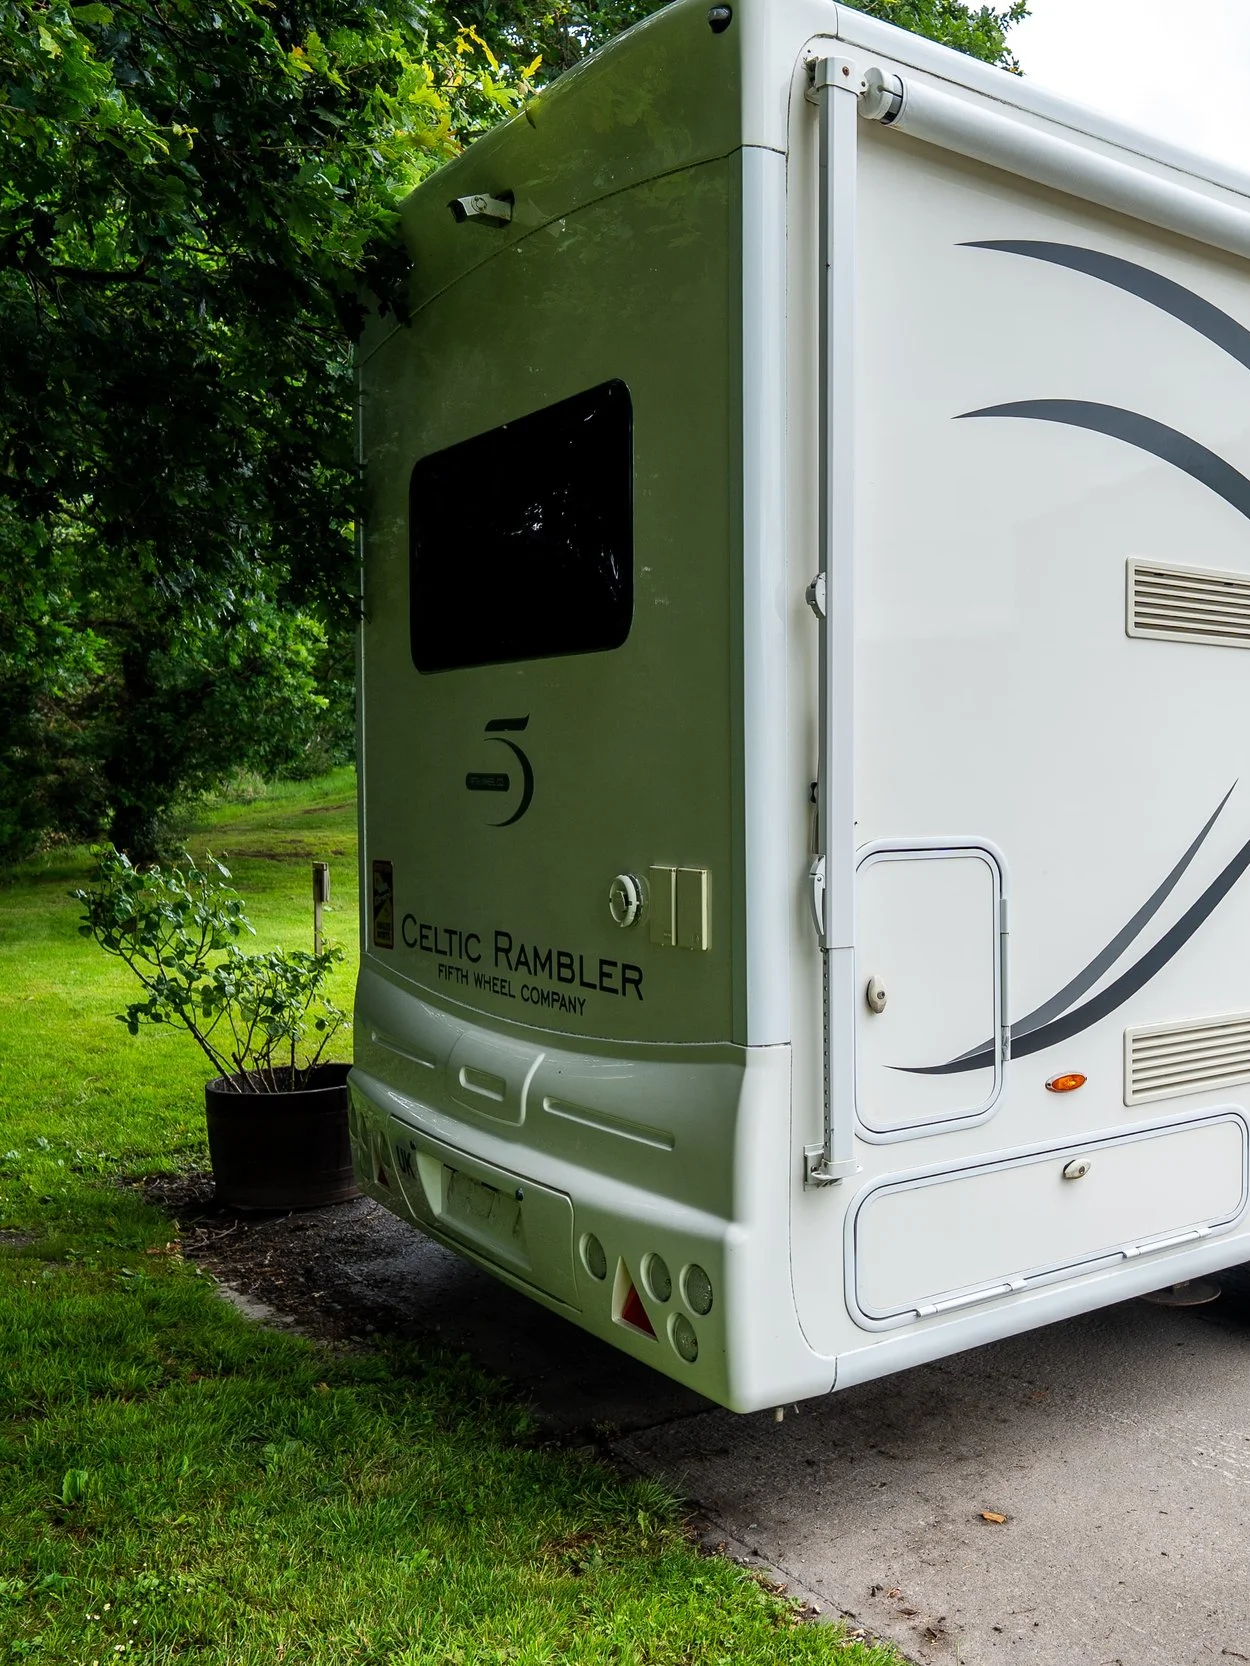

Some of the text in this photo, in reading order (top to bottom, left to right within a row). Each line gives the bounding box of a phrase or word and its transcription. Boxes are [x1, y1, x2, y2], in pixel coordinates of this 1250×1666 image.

[401, 913, 644, 1001] CELTIC RAMBLER
[438, 963, 587, 1017] FIFTH WHEEL COMPANY
[395, 1145, 416, 1180] UK
